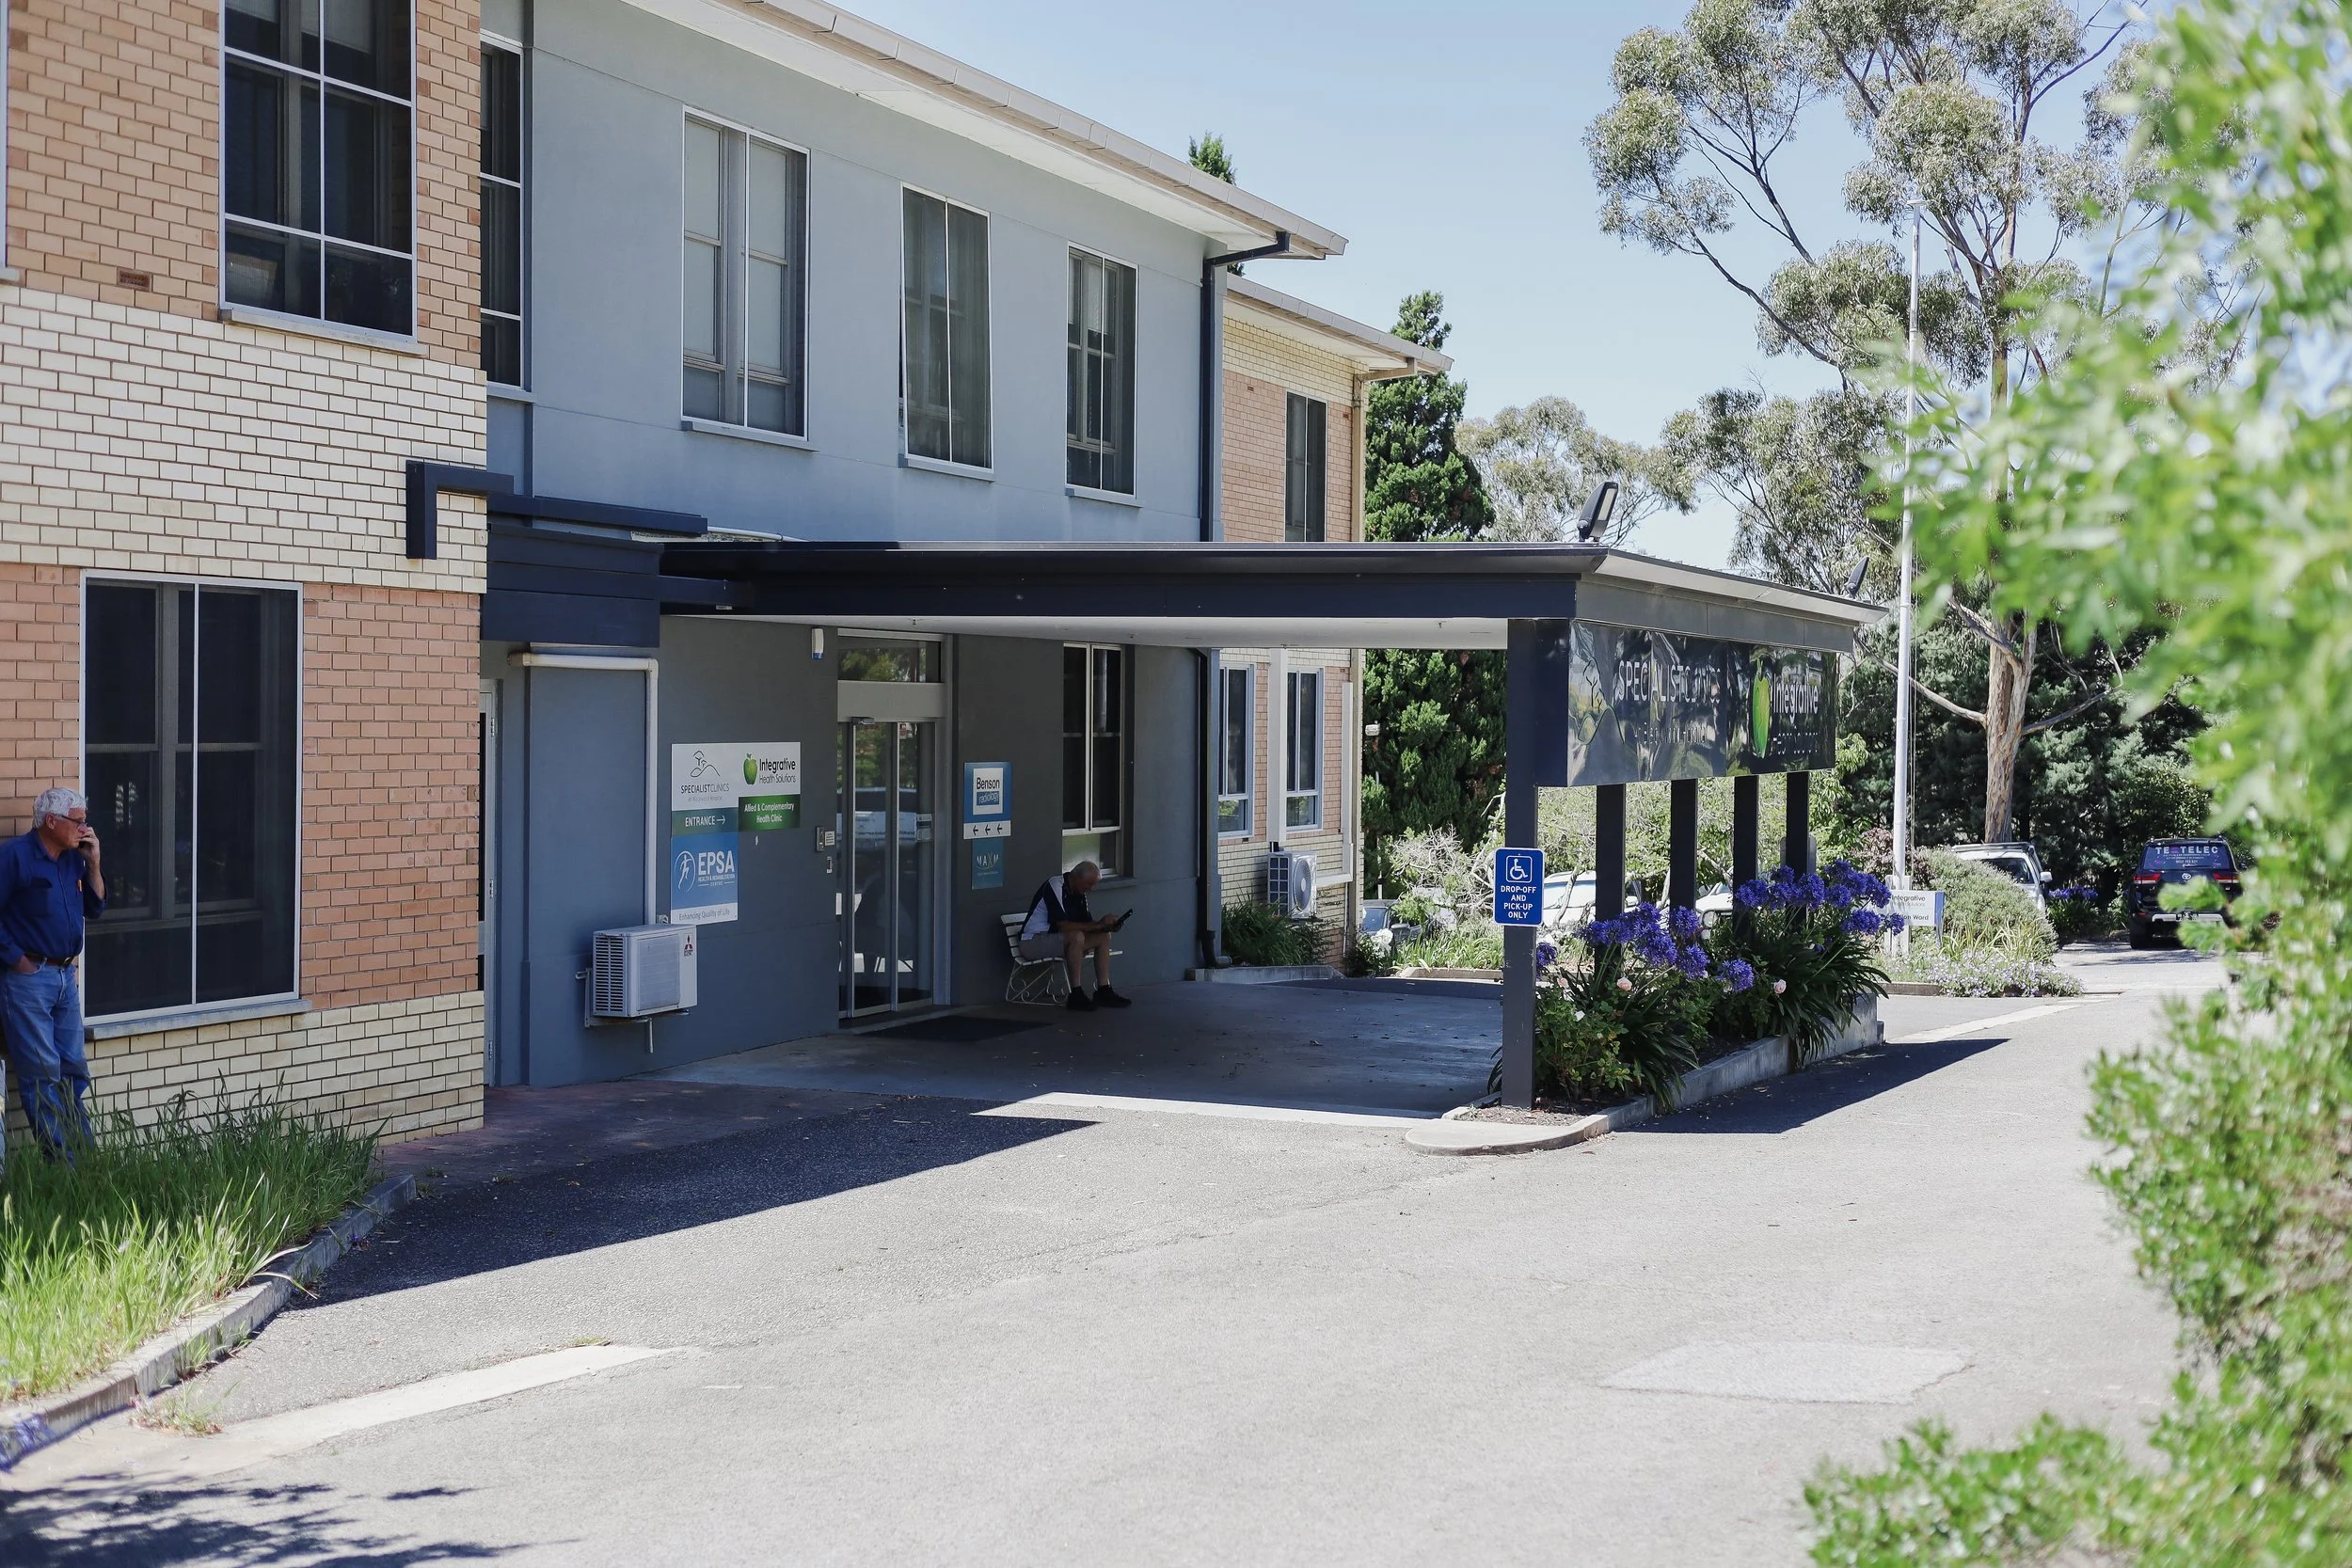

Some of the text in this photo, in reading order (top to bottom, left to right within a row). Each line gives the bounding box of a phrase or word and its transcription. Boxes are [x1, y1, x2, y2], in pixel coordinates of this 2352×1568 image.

[1773, 673, 1819, 724] Integrative
[759, 757, 796, 773] Integrative
[759, 773, 797, 784] Health Solutions
[976, 777, 1000, 789] Benson
[978, 791, 999, 803] radiology
[744, 803, 757, 812] Allied
[761, 802, 795, 812] Complementary
[685, 815, 716, 828] ENTRANCE
[756, 814, 783, 823] Health Clinic
[698, 850, 735, 876] EPSA
[1501, 885, 1537, 894] DROP-OFF
[678, 912, 701, 921] Enhancing
[701, 910, 717, 918] Quality
[1508, 911, 1529, 919] ONLY
